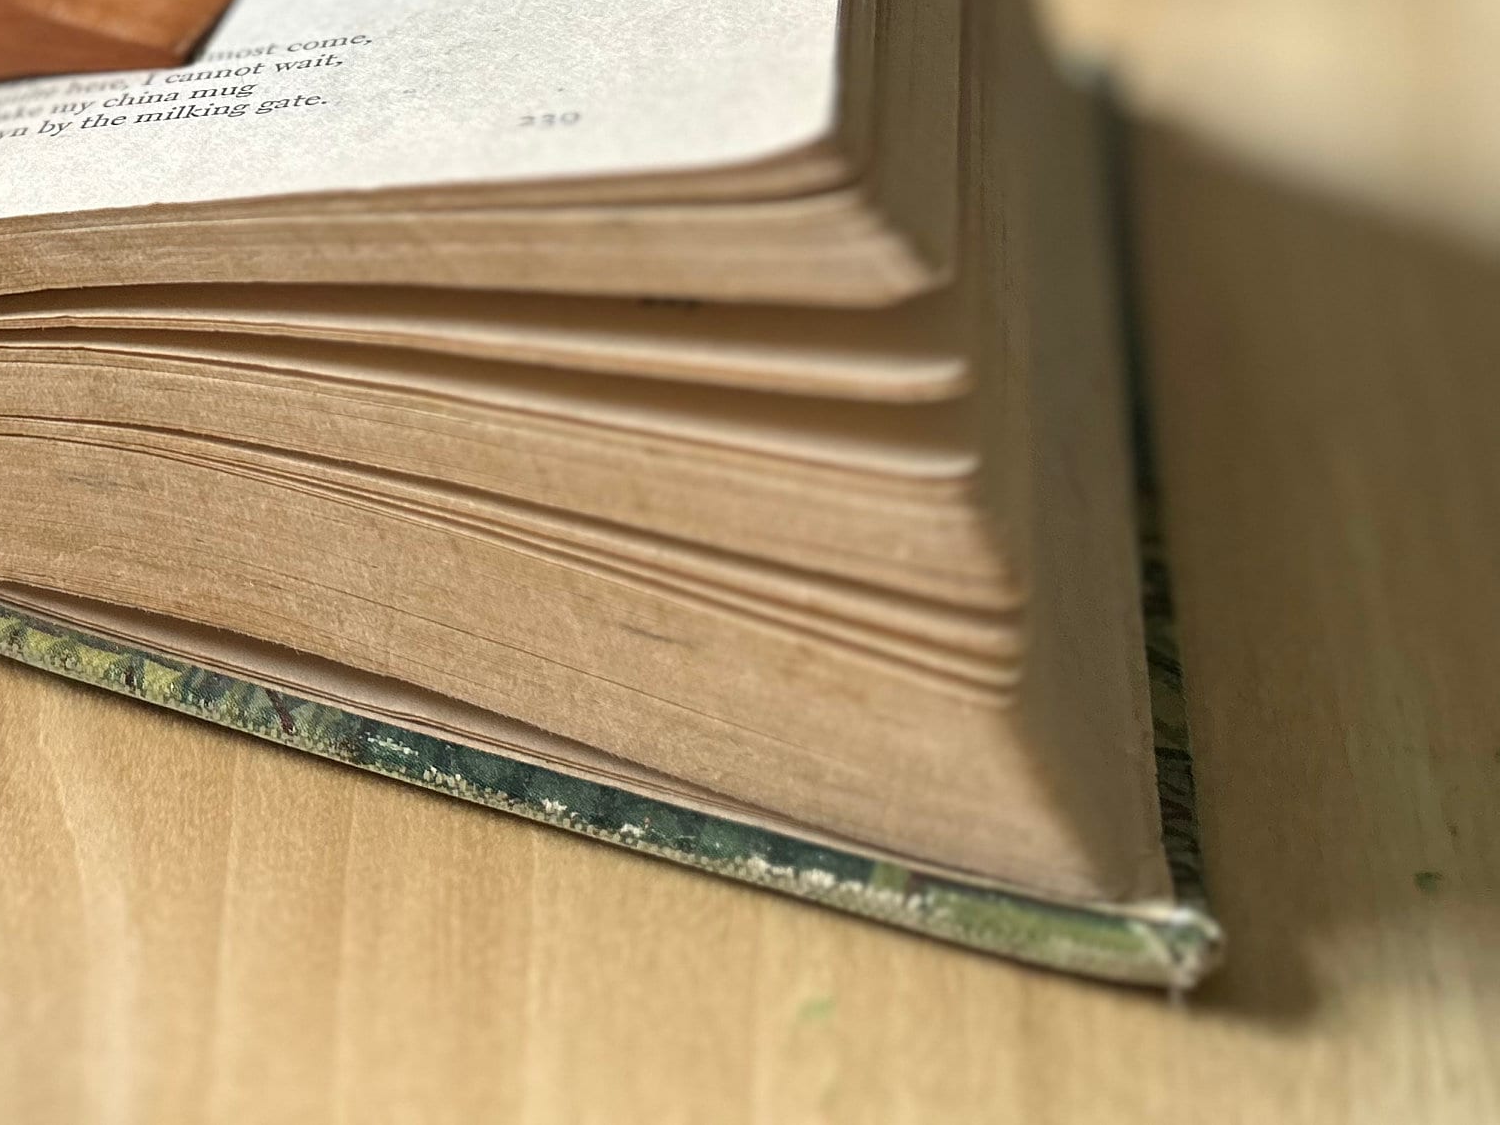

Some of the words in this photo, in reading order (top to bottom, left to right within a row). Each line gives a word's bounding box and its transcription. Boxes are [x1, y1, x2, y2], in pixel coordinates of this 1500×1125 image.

[287, 33, 373, 53] come,
[165, 62, 266, 84] cannot
[275, 53, 344, 73] wait,
[37, 119, 73, 138] by
[80, 112, 128, 130] the
[133, 101, 251, 125] milking
[255, 93, 329, 115] gate.
[50, 100, 97, 117] my
[102, 87, 180, 108] china
[190, 83, 259, 99] mug
